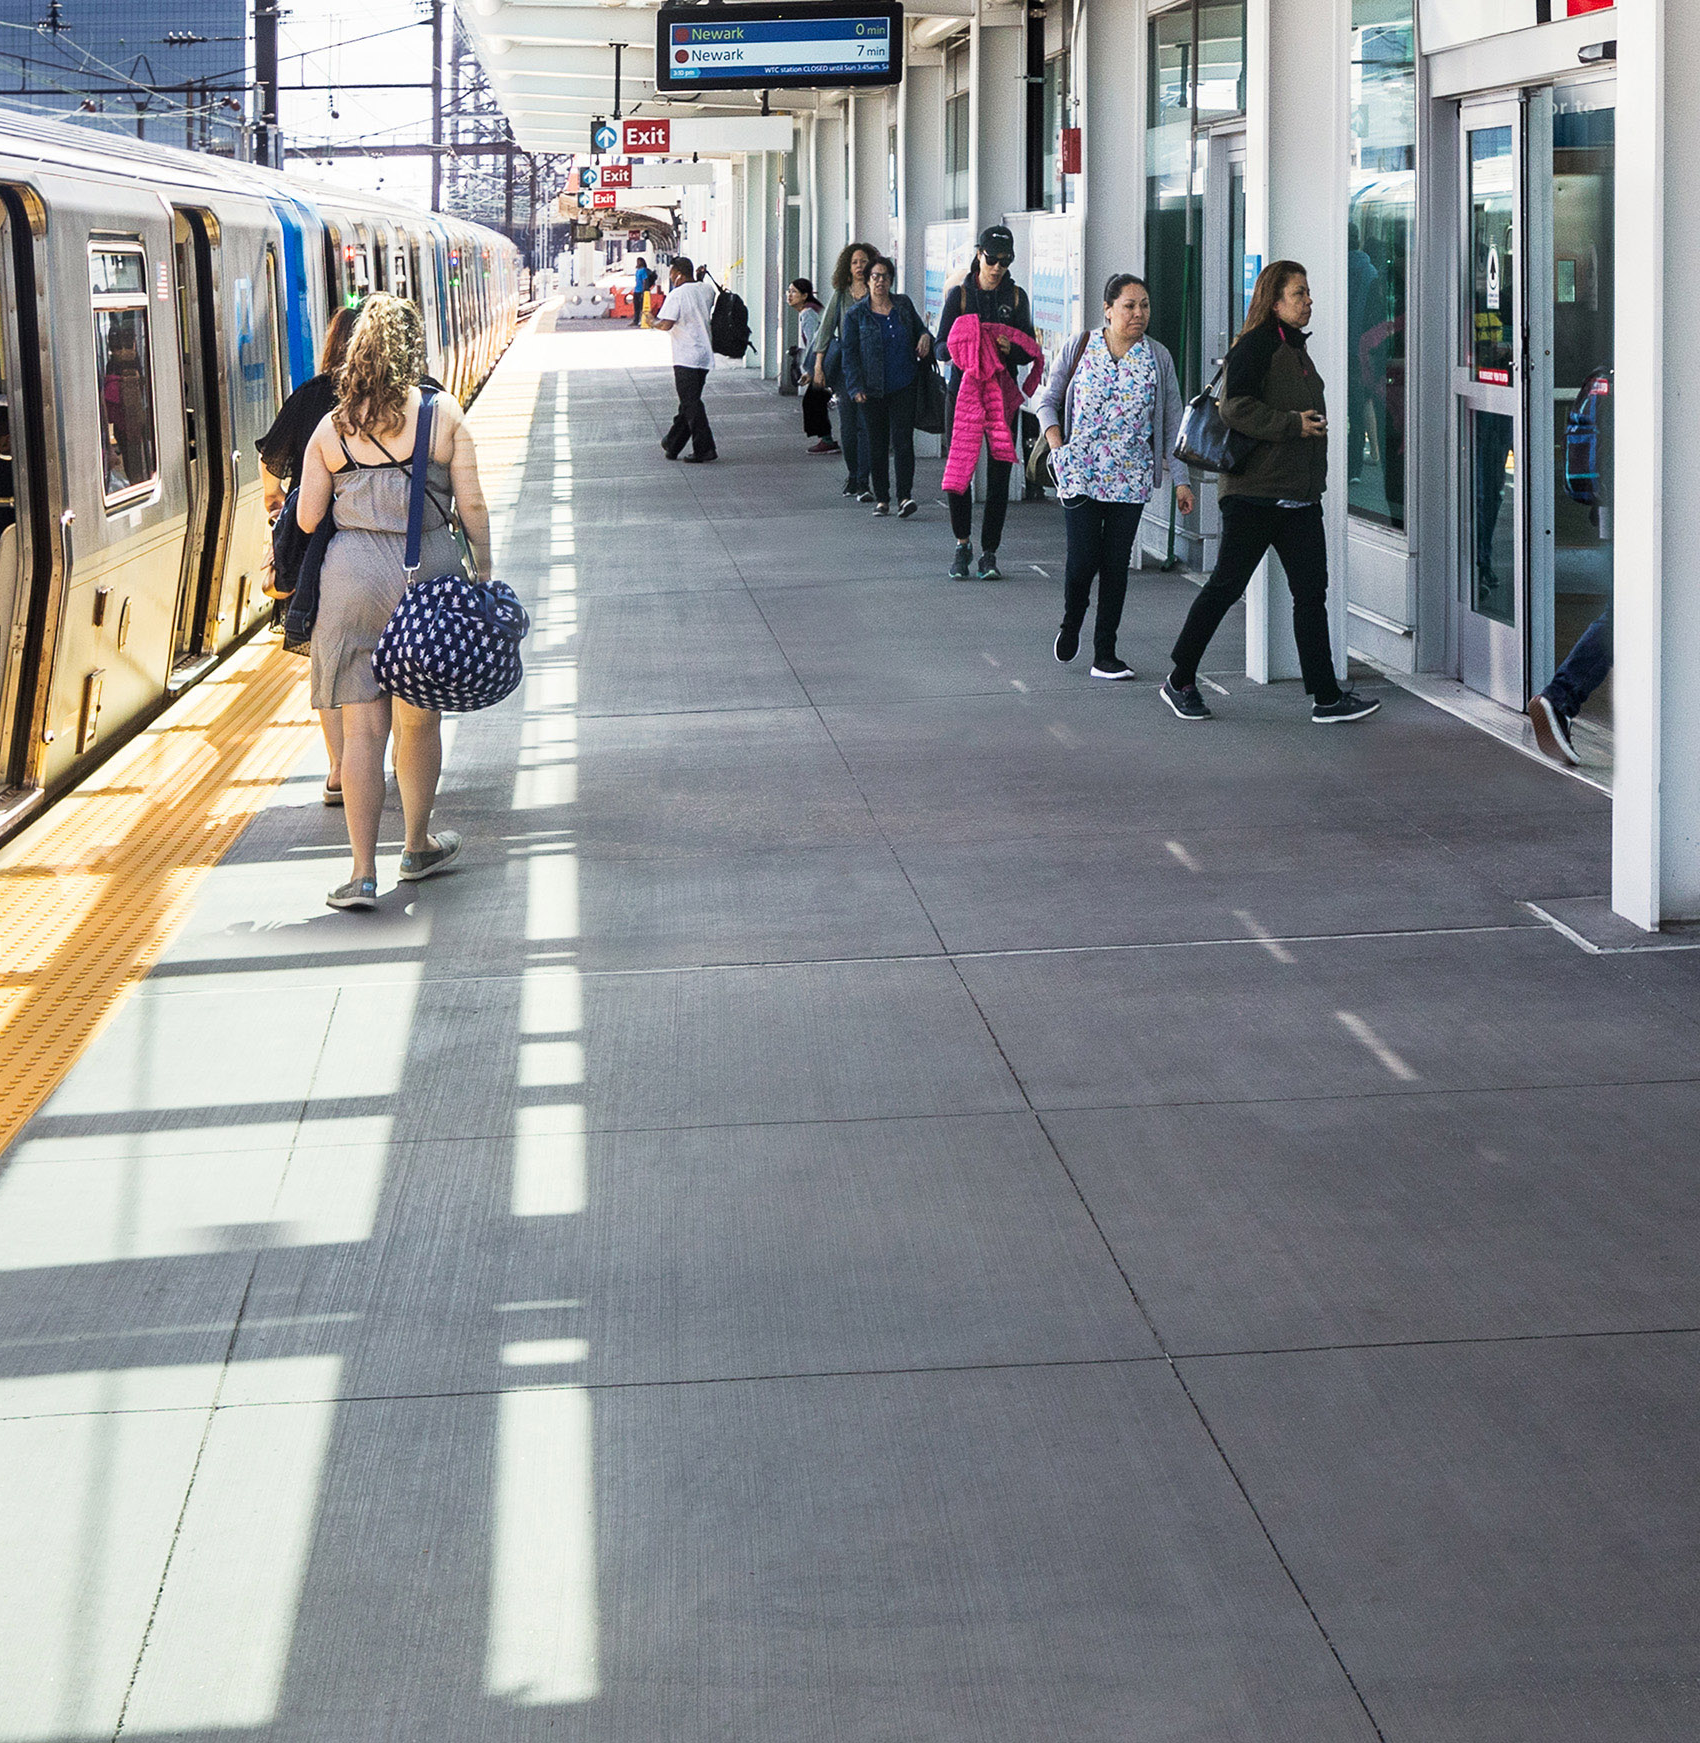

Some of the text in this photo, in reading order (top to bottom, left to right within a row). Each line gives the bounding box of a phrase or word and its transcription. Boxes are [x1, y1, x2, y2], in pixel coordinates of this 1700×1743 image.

[691, 23, 886, 41] Newark 0 min
[691, 44, 885, 62] Newark 7 min
[764, 66, 779, 74] WTC
[780, 65, 802, 73] station
[803, 64, 828, 73] CLOSED
[626, 126, 666, 145] Exit
[603, 169, 630, 182] Exit
[594, 193, 615, 204] Exit
